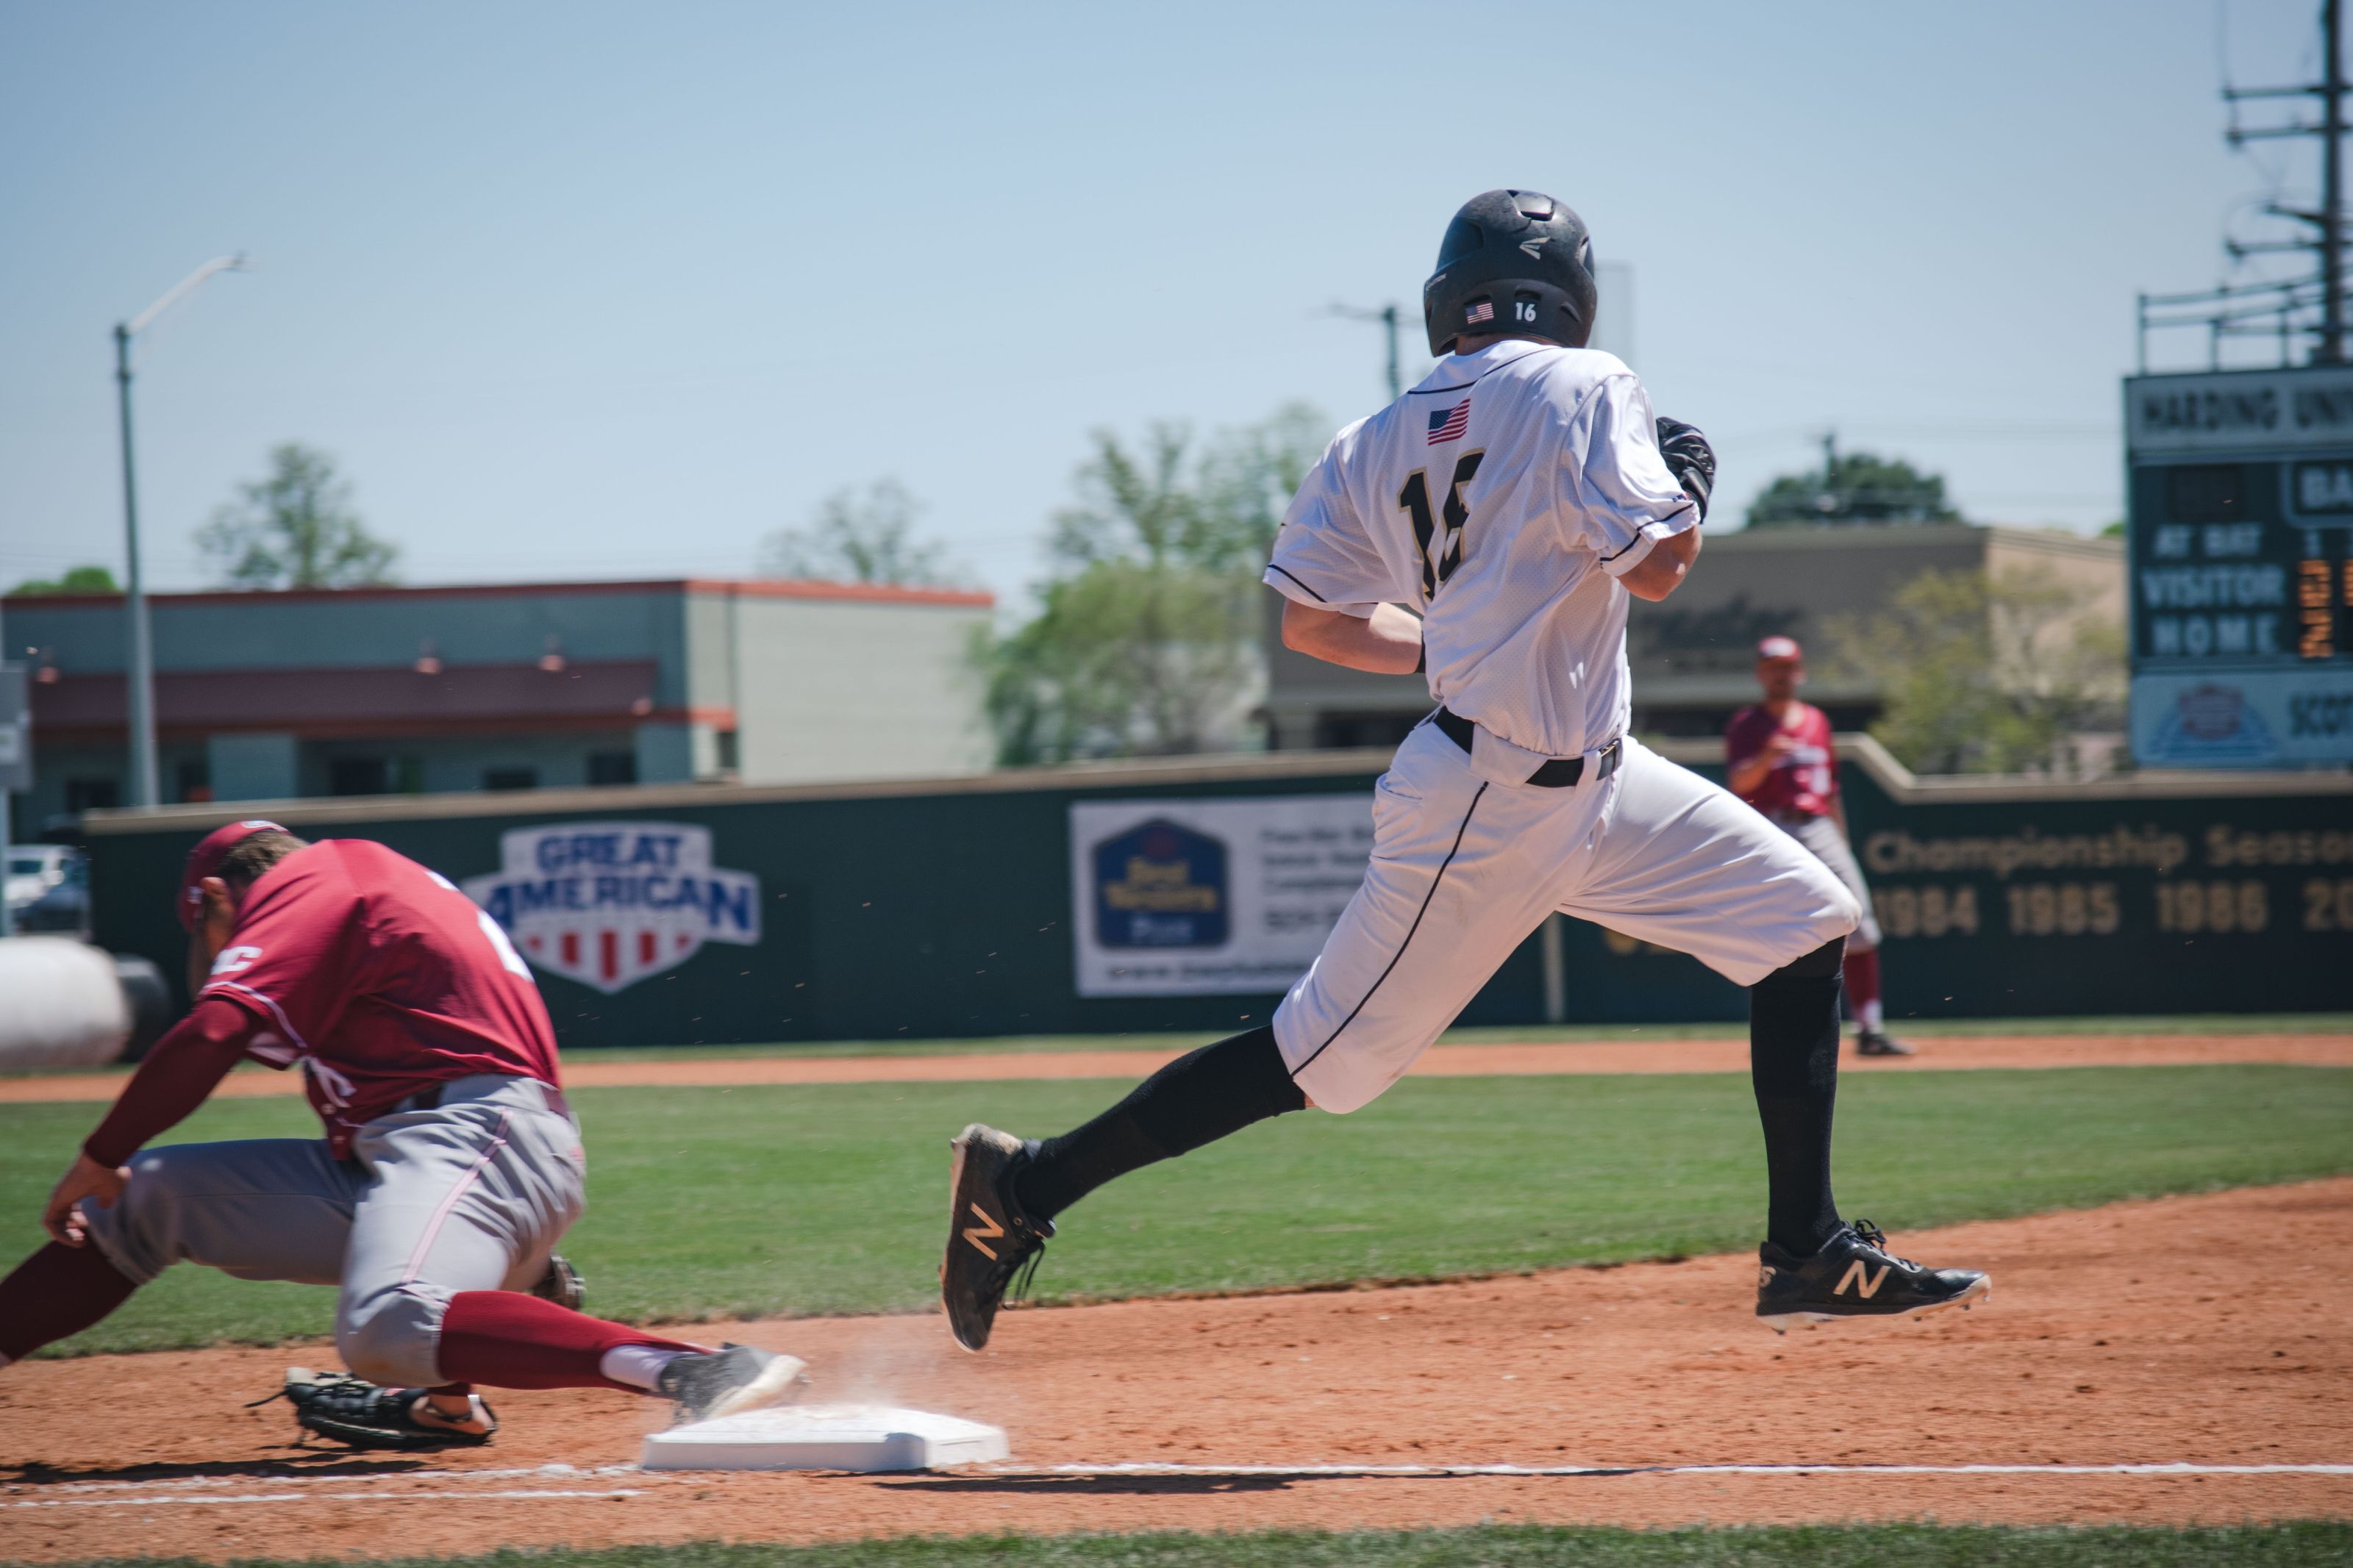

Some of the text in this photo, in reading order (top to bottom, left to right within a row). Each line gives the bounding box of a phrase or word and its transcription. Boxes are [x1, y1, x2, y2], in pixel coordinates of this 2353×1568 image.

[1515, 302, 1536, 322] 16
[1398, 447, 1486, 603] 16
[2141, 563, 2285, 609] VISITOR
[2153, 612, 2278, 654] HOME
[537, 834, 681, 873] GREAT
[1866, 823, 2187, 881] Championship
[485, 876, 750, 931] AMERICAN
[1873, 887, 1979, 937] 1984
[2006, 884, 2119, 935] 1985
[2156, 881, 2268, 934] 1986
[1833, 1259, 1892, 1299] N
